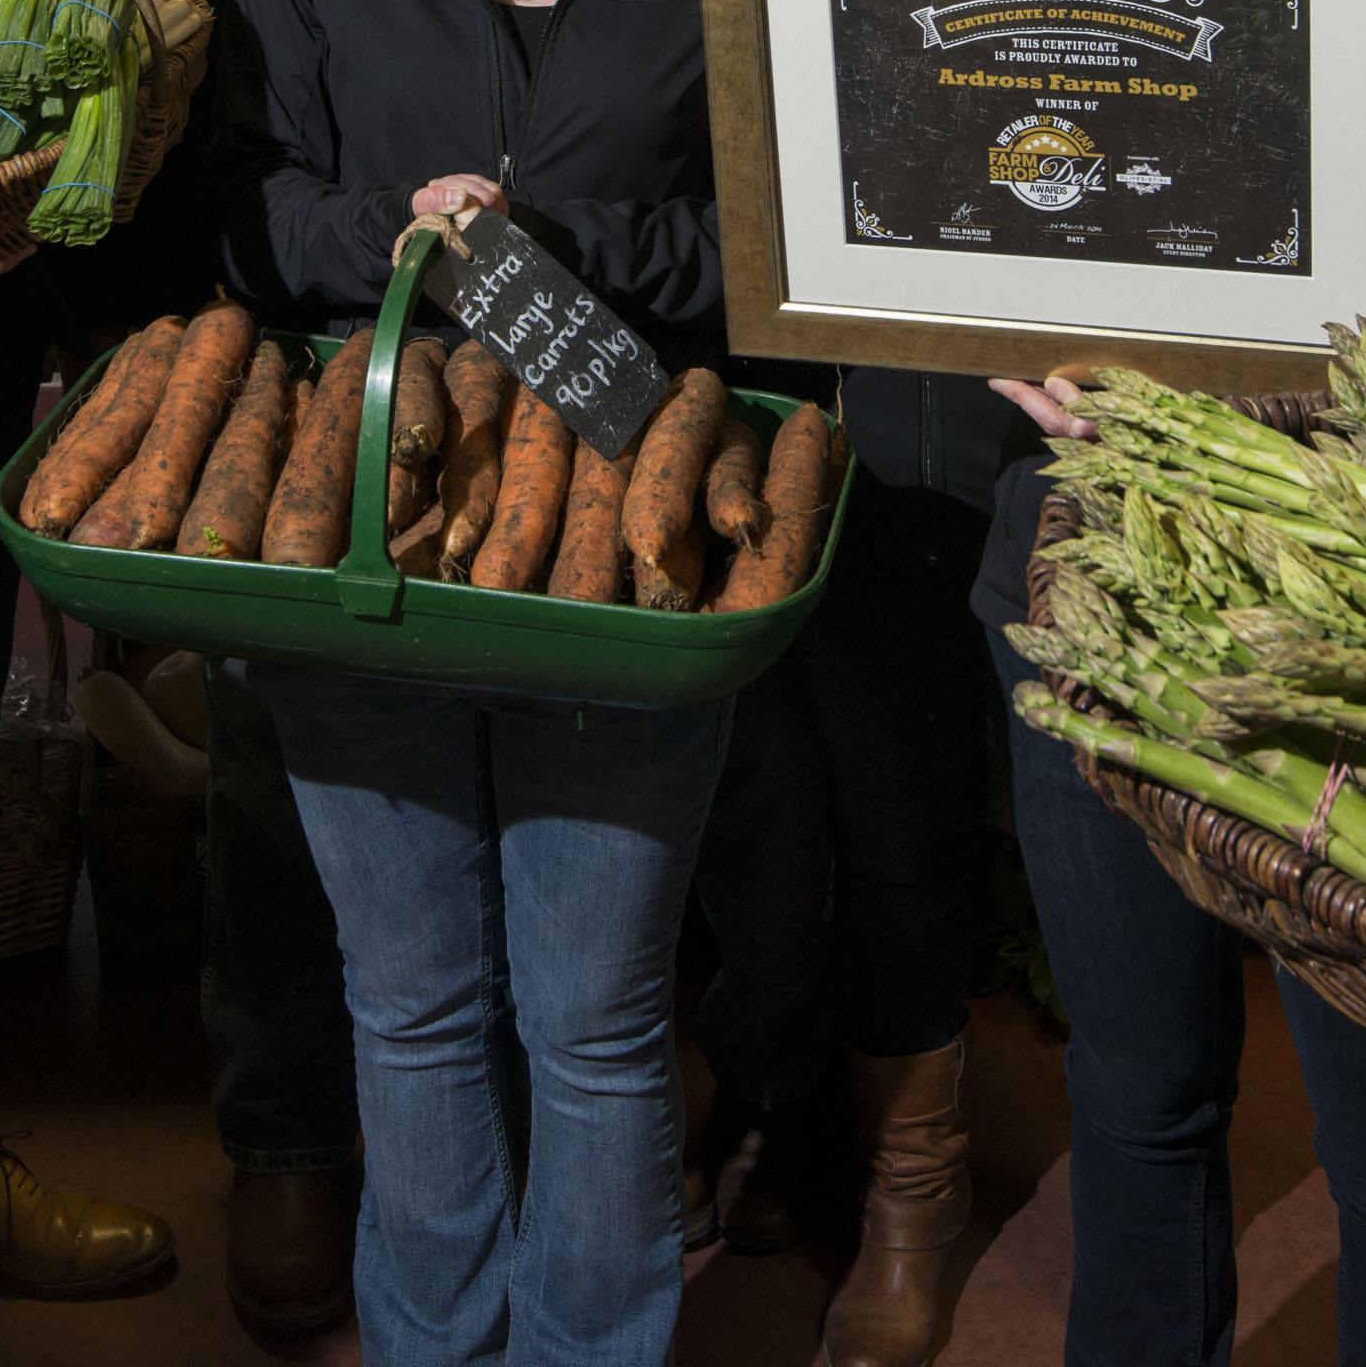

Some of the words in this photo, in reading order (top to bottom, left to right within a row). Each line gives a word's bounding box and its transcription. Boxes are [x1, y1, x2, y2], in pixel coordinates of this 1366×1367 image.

[945, 8, 1044, 33] CERTIFICATE
[1047, 8, 1067, 19] OF
[1071, 8, 1187, 43] ACHIEVEMENT
[1012, 38, 1040, 49] THIS
[1042, 39, 1119, 52] CERTIFICATE
[994, 51, 1006, 61] IS
[1009, 51, 1062, 64] PROUDLY
[1064, 54, 1120, 66] AWARDED
[1123, 56, 1138, 67] TO
[938, 68, 1043, 90] Ardross
[1048, 74, 1122, 94] Farm
[1128, 78, 1198, 101] Shop
[1035, 98, 1082, 110] WINNER
[1084, 100, 1099, 111] OF
[996, 115, 1039, 147] RETAILER
[1038, 115, 1052, 126] OF
[1052, 116, 1074, 133] THE
[1070, 124, 1096, 151] YEAR
[988, 152, 1038, 167] FARM
[989, 167, 1040, 181] SHOP
[1039, 156, 1106, 186] Deli
[1043, 163, 1052, 173] &
[1029, 184, 1068, 195] AWARDS
[1039, 194, 1058, 203] 2014
[939, 227, 961, 235] NIGEL
[961, 228, 991, 236] BARDEN
[1060, 222, 1084, 231] March
[1066, 235, 1085, 243] DATE
[1155, 242, 1175, 250] JACK
[1176, 244, 1213, 252] HALLIDAY
[460, 254, 523, 329] Extra
[490, 290, 553, 355] Large
